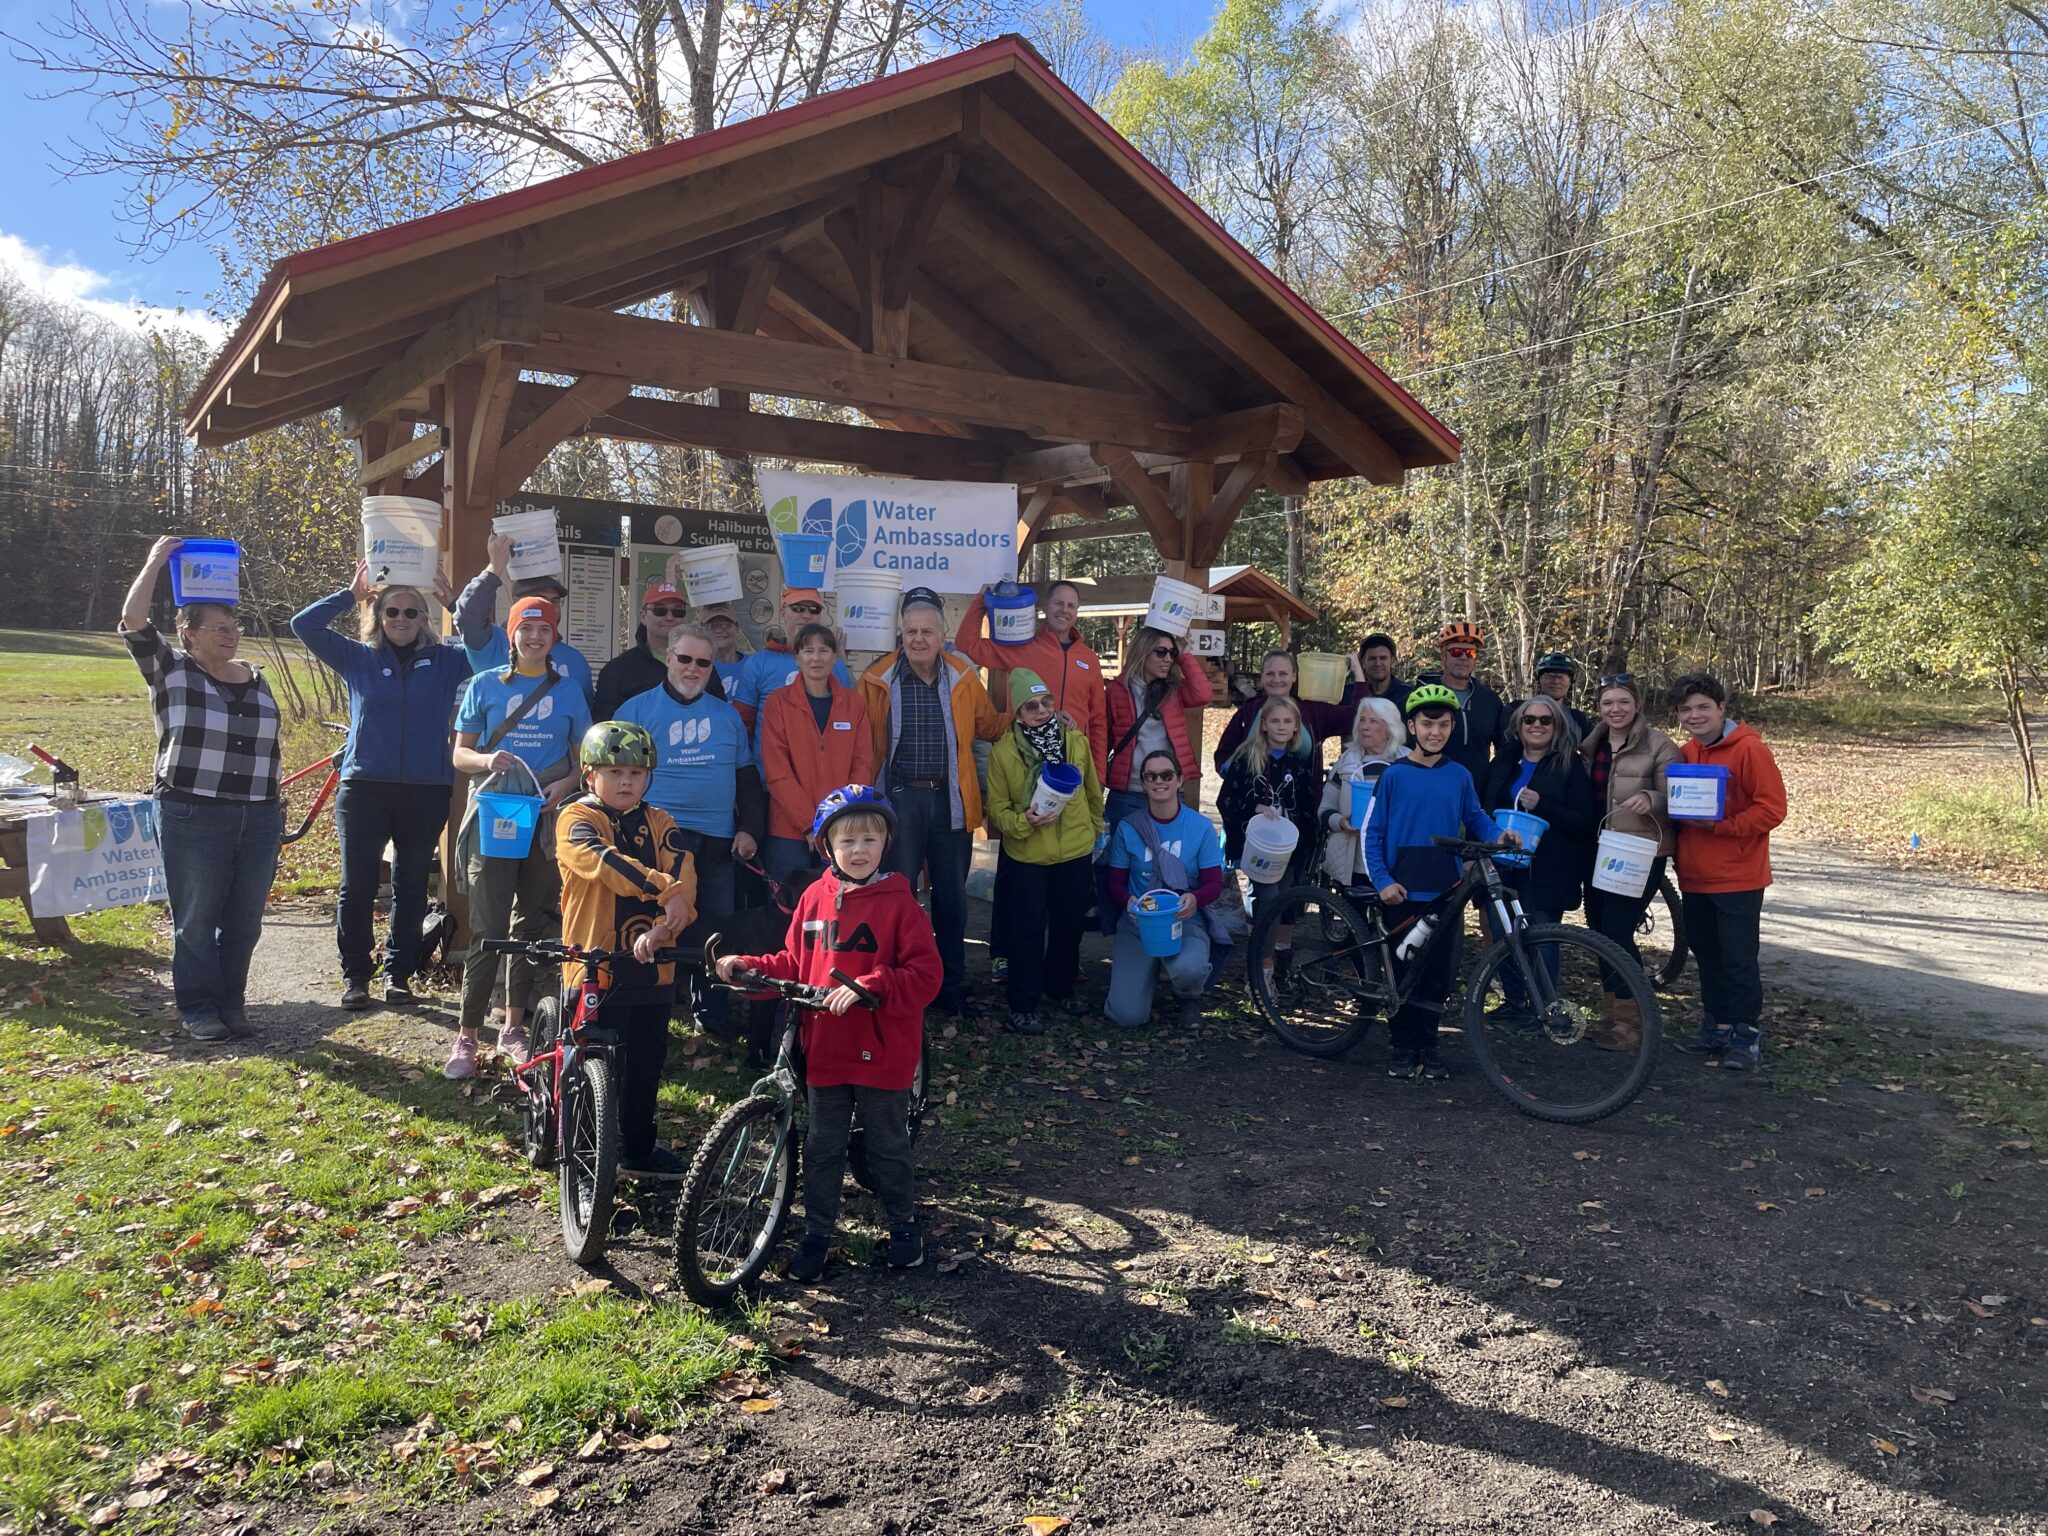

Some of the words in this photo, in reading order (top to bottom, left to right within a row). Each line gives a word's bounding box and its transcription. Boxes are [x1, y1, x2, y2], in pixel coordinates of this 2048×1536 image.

[873, 500, 936, 521] Water
[557, 525, 582, 539] ails
[708, 519, 769, 535] Haliburto
[755, 538, 775, 551] For
[874, 526, 1011, 548] Ambassadors
[874, 550, 949, 570] Canada
[513, 740, 542, 748] Canada
[667, 754, 715, 764] Ambassadors
[102, 848, 156, 865] Water
[106, 880, 166, 902] Canad
[802, 919, 879, 953] FILA
